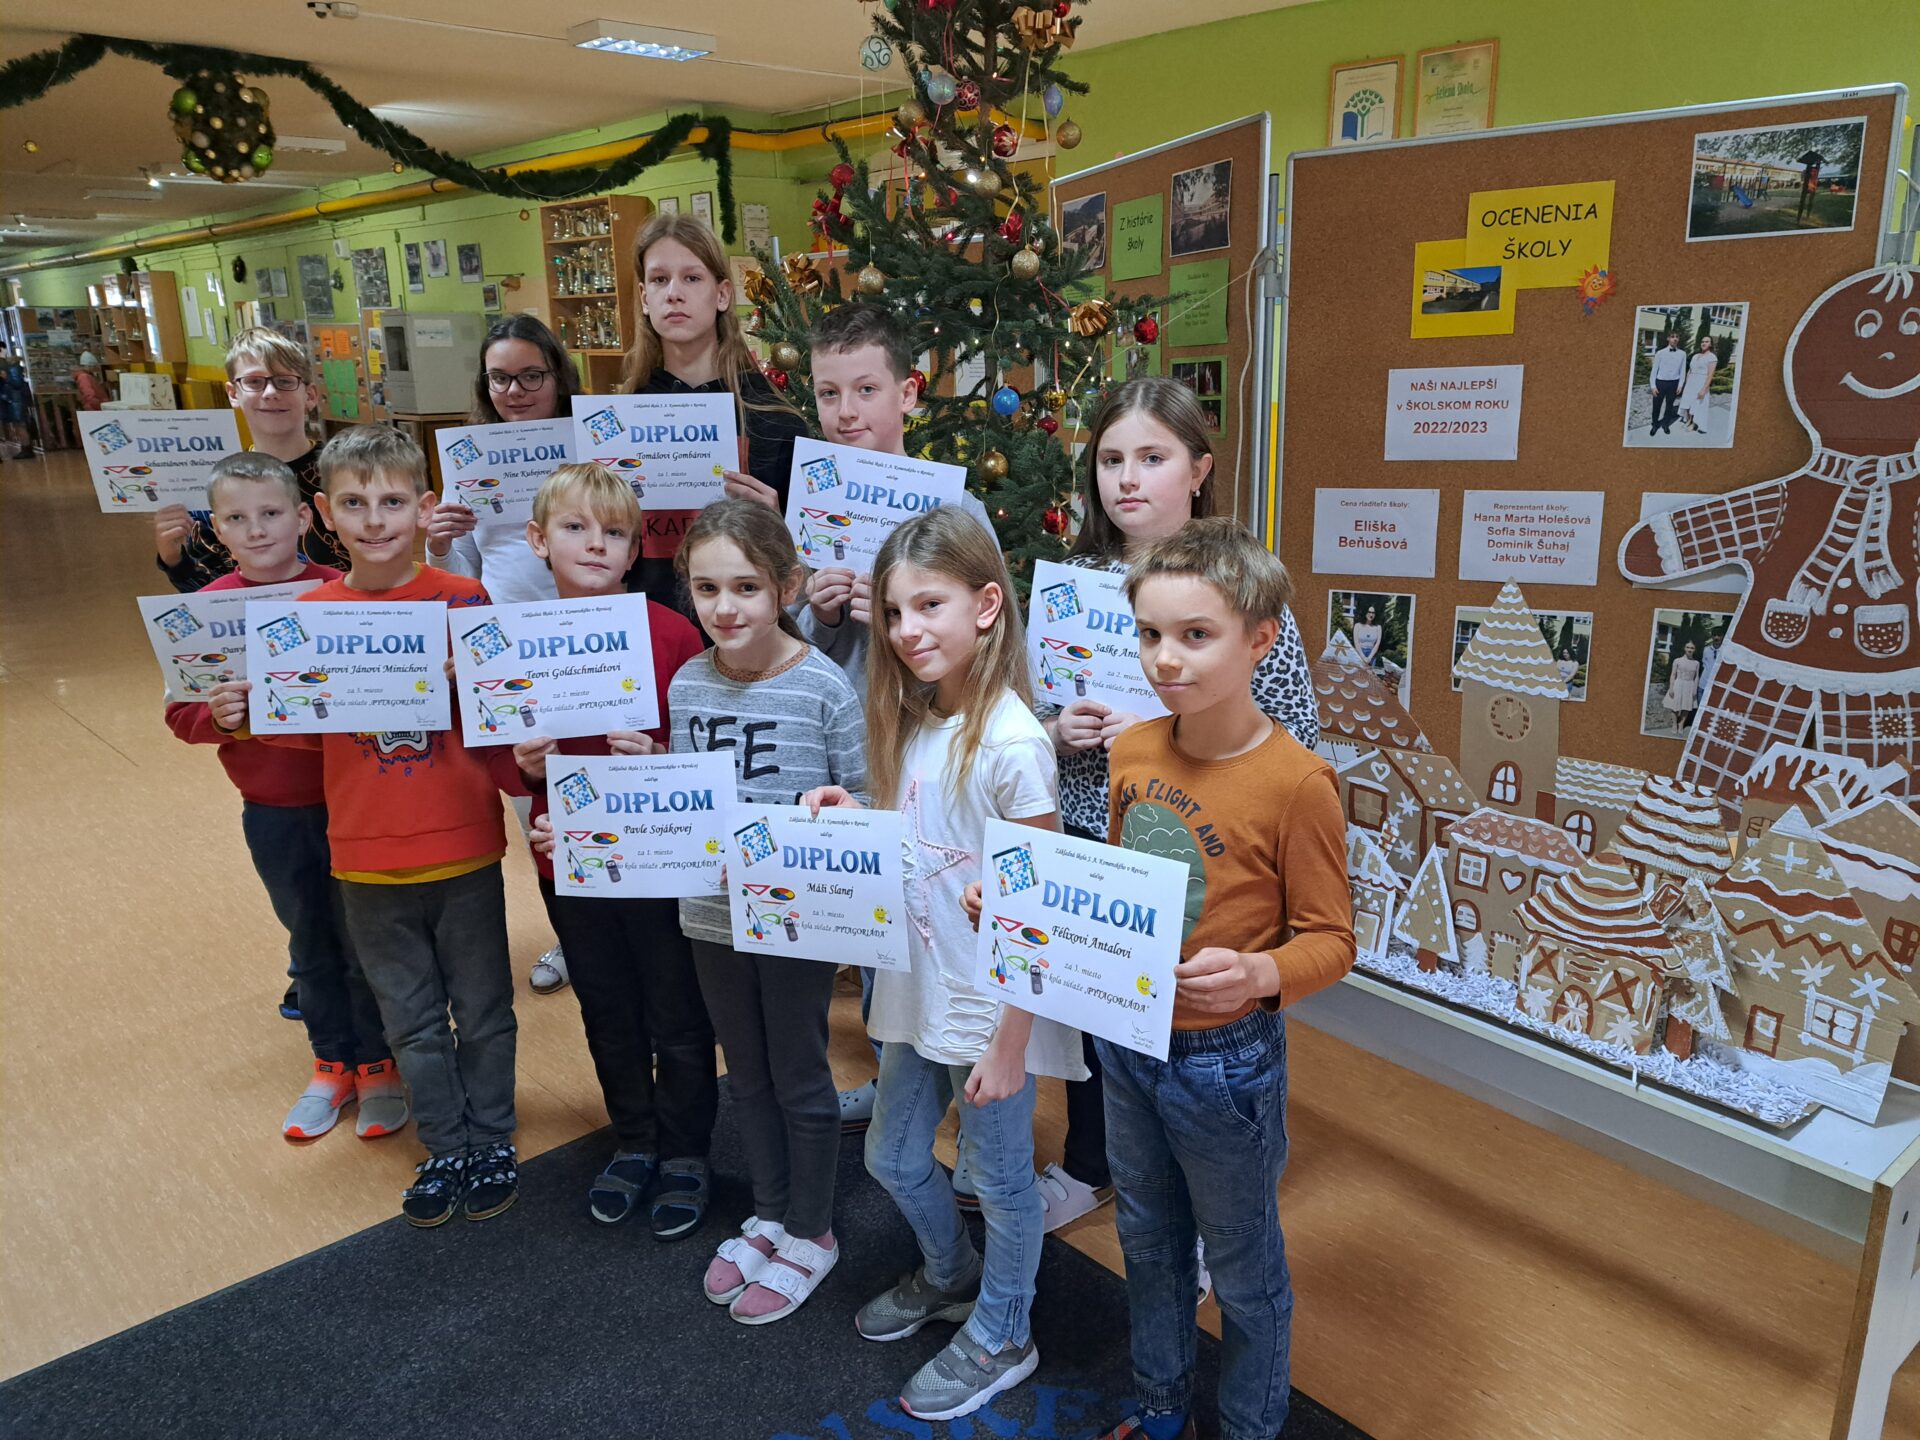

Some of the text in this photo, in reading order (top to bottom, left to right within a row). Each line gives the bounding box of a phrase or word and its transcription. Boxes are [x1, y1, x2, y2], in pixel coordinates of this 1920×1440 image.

[1482, 203, 1598, 228] OCENENIA
[1119, 217, 1126, 231] Z
[1127, 237, 1144, 252] školy
[1502, 237, 1572, 260] ŠKOLY
[1410, 378, 1498, 391] NAŠI NAJLEPŠÍ
[1406, 400, 1472, 411] ŠKOLSKOM
[1475, 400, 1509, 410] ROKU
[630, 424, 720, 444] DIPLOM
[1413, 421, 1488, 434] 2022/2023
[136, 436, 225, 453] DIPLOM
[488, 444, 567, 466] DIPLOM
[845, 481, 942, 513] DIPLOM
[1546, 504, 1569, 512] školy:
[844, 510, 878, 524] Matejovi
[1474, 513, 1591, 525] Hana Marta Holešová
[1354, 520, 1396, 533] Eliška
[1487, 527, 1576, 538] Sofia Simanová
[1338, 536, 1408, 550] Beňušová
[1488, 539, 1570, 552] Dominik Šuhaj
[1492, 553, 1566, 567] Jakub Vattay
[316, 634, 426, 655] DIPLOM
[518, 630, 630, 660] DIPLOM
[1094, 642, 1119, 657] Saške
[309, 663, 428, 674] Oskarovi Jánovi Minichovi
[525, 662, 621, 680] Teovi Goldschmidtovi
[604, 789, 715, 814] DIPLOM
[1146, 778, 1202, 819] FLIGHT
[1195, 823, 1226, 858] AND
[623, 822, 693, 837] Pavle Sojákovej
[783, 845, 882, 876] DIPLOM
[829, 884, 854, 899] Slanej
[1042, 880, 1158, 938] DIPLOM
[1052, 925, 1133, 959] Félixovi Antalovi
[1064, 962, 1072, 970] za
[1082, 967, 1102, 980] miesto
[1049, 973, 1062, 985] kola
